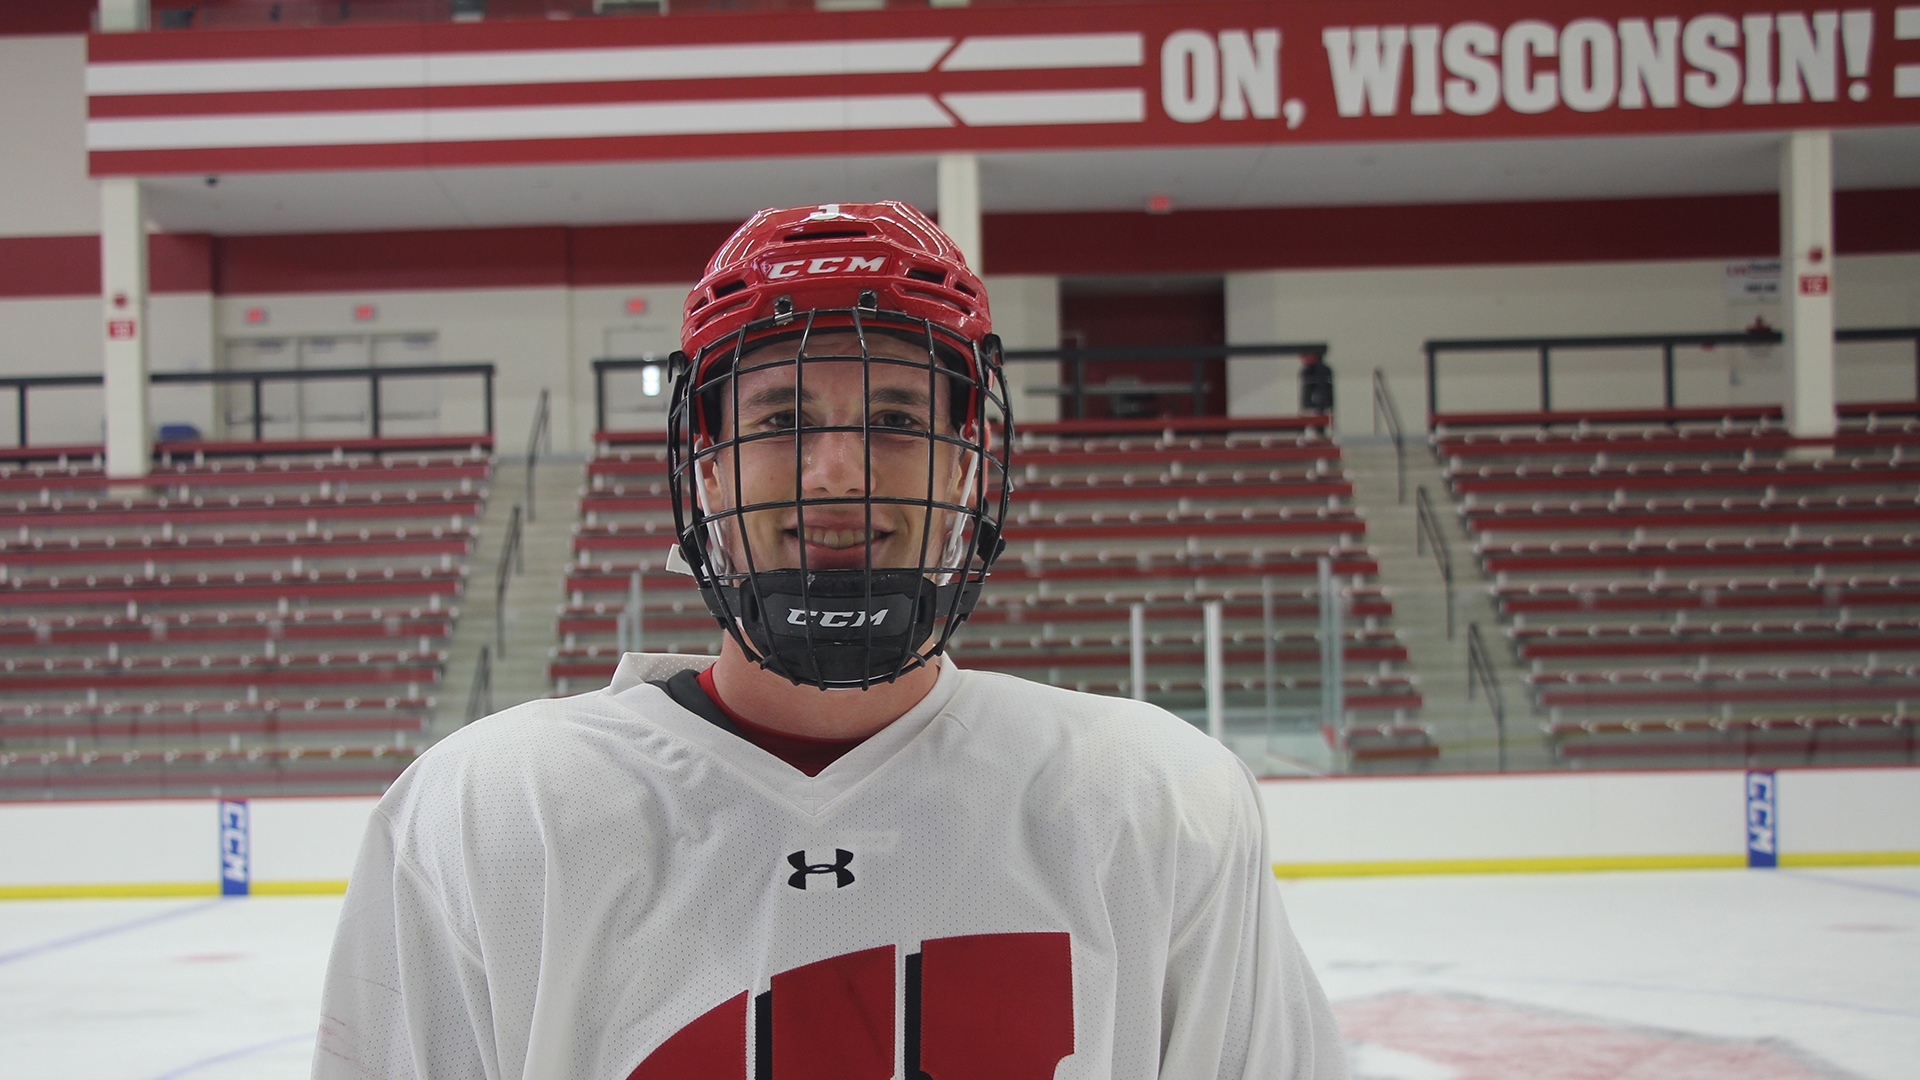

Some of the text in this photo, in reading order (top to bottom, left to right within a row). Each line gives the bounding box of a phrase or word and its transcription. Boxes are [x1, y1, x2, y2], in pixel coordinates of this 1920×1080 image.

[1160, 9, 1874, 130] ON, WISCONSIN!
[768, 256, 887, 279] CCM
[786, 608, 889, 628] CCM
[222, 801, 246, 882] CCM
[1748, 773, 1774, 854] CCM
